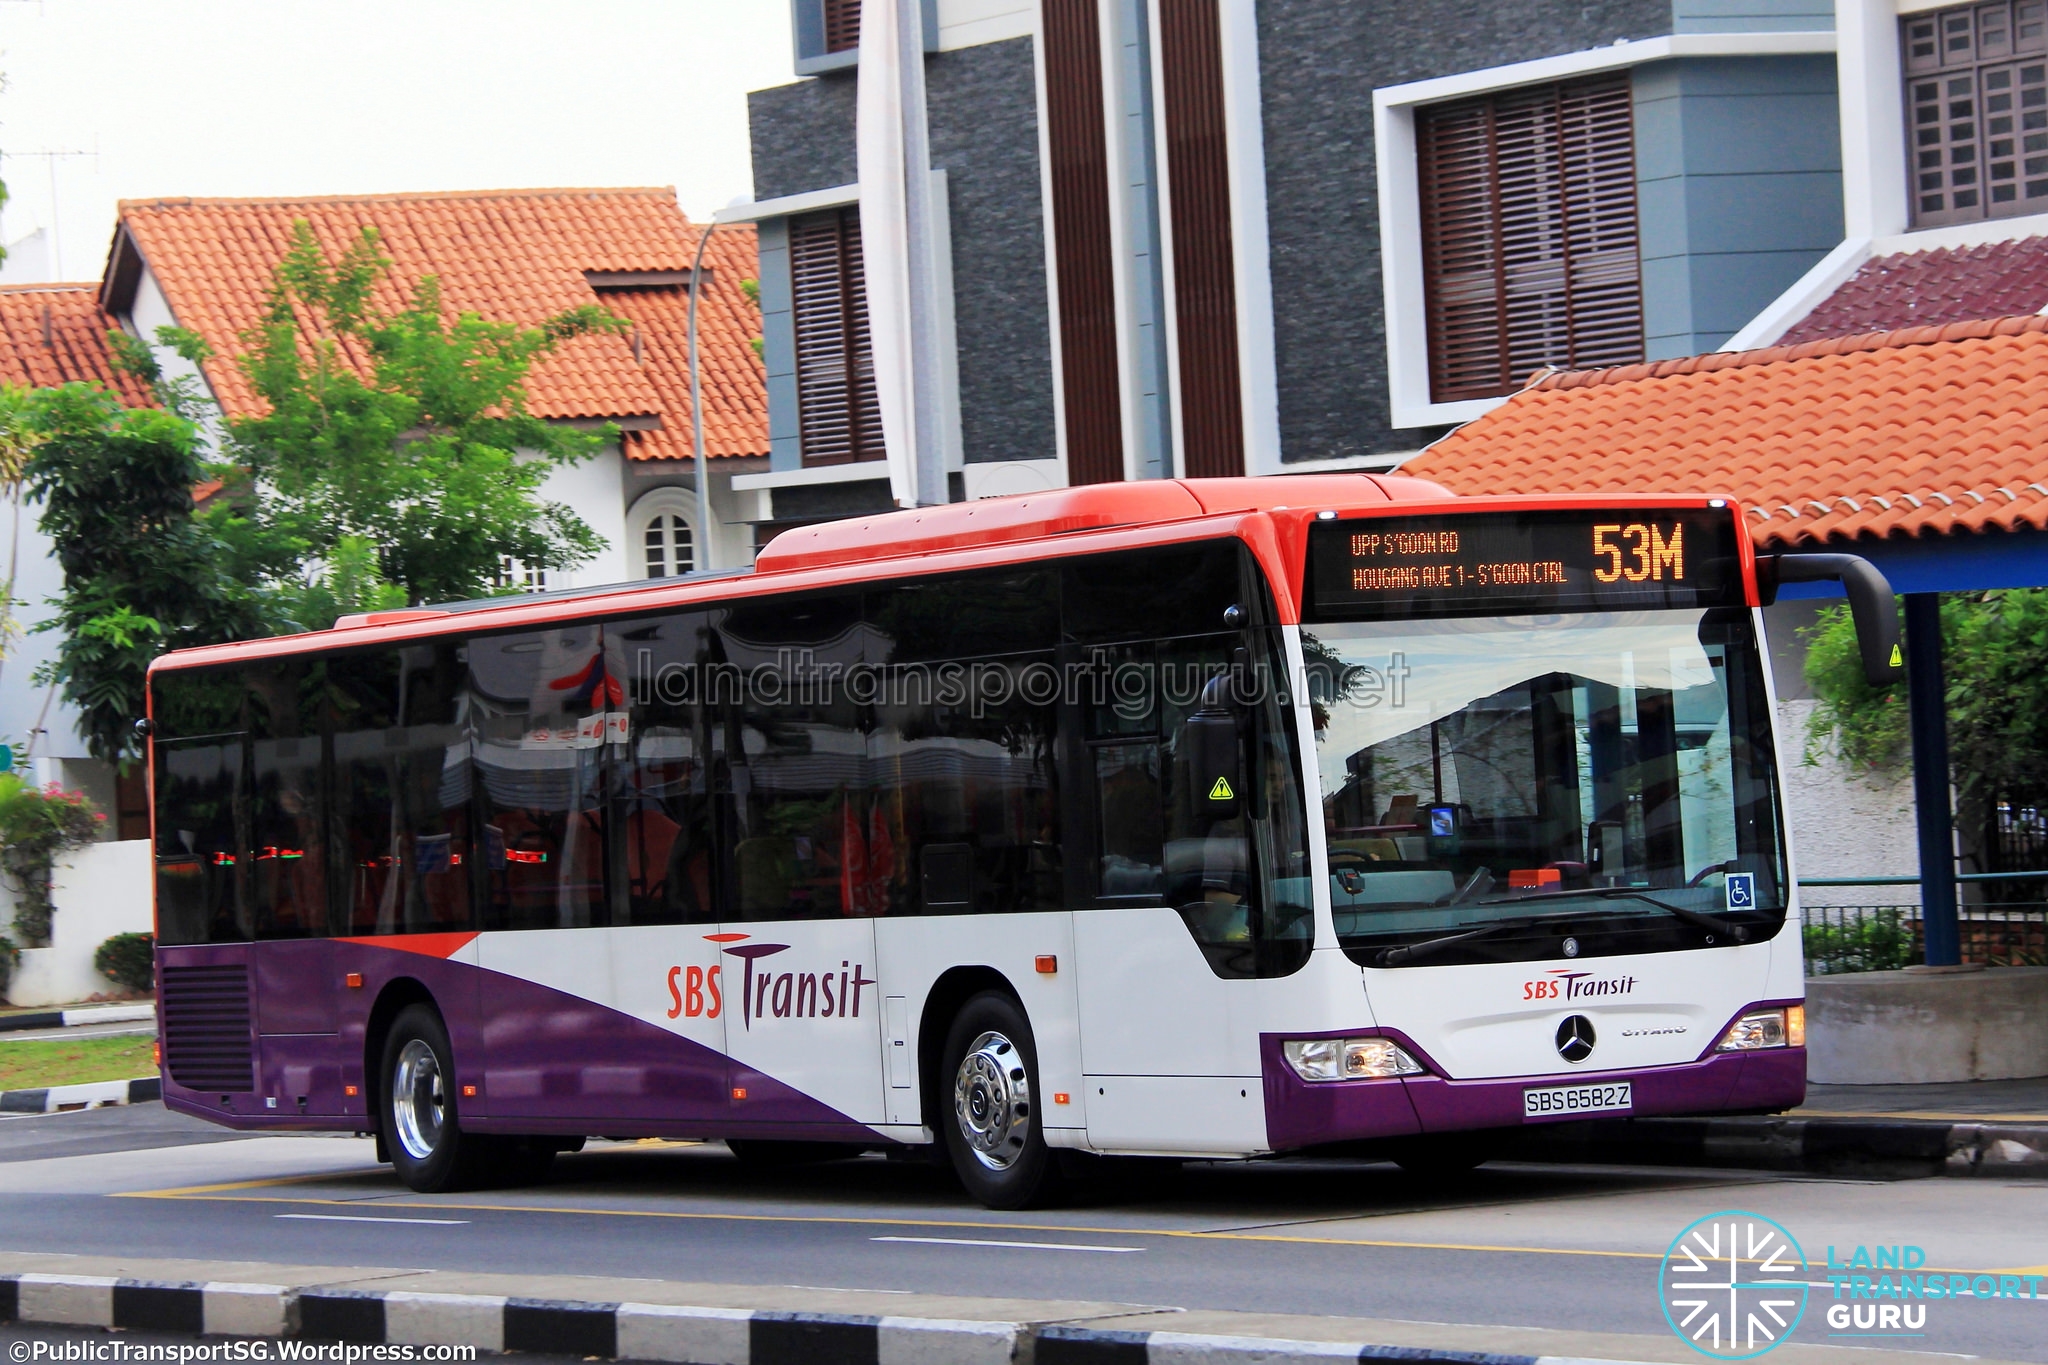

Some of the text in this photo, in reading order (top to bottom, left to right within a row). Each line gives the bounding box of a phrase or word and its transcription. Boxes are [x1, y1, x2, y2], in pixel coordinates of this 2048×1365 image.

[1352, 531, 1459, 556] UPP S'GOON RD
[1593, 523, 1683, 583] 53M
[1353, 567, 1419, 590] HOUGANG
[1422, 566, 1452, 587] AVE
[1533, 561, 1568, 583] CTRL
[667, 943, 877, 1032] SBS Transit
[1523, 972, 1640, 1001] SBS Transit
